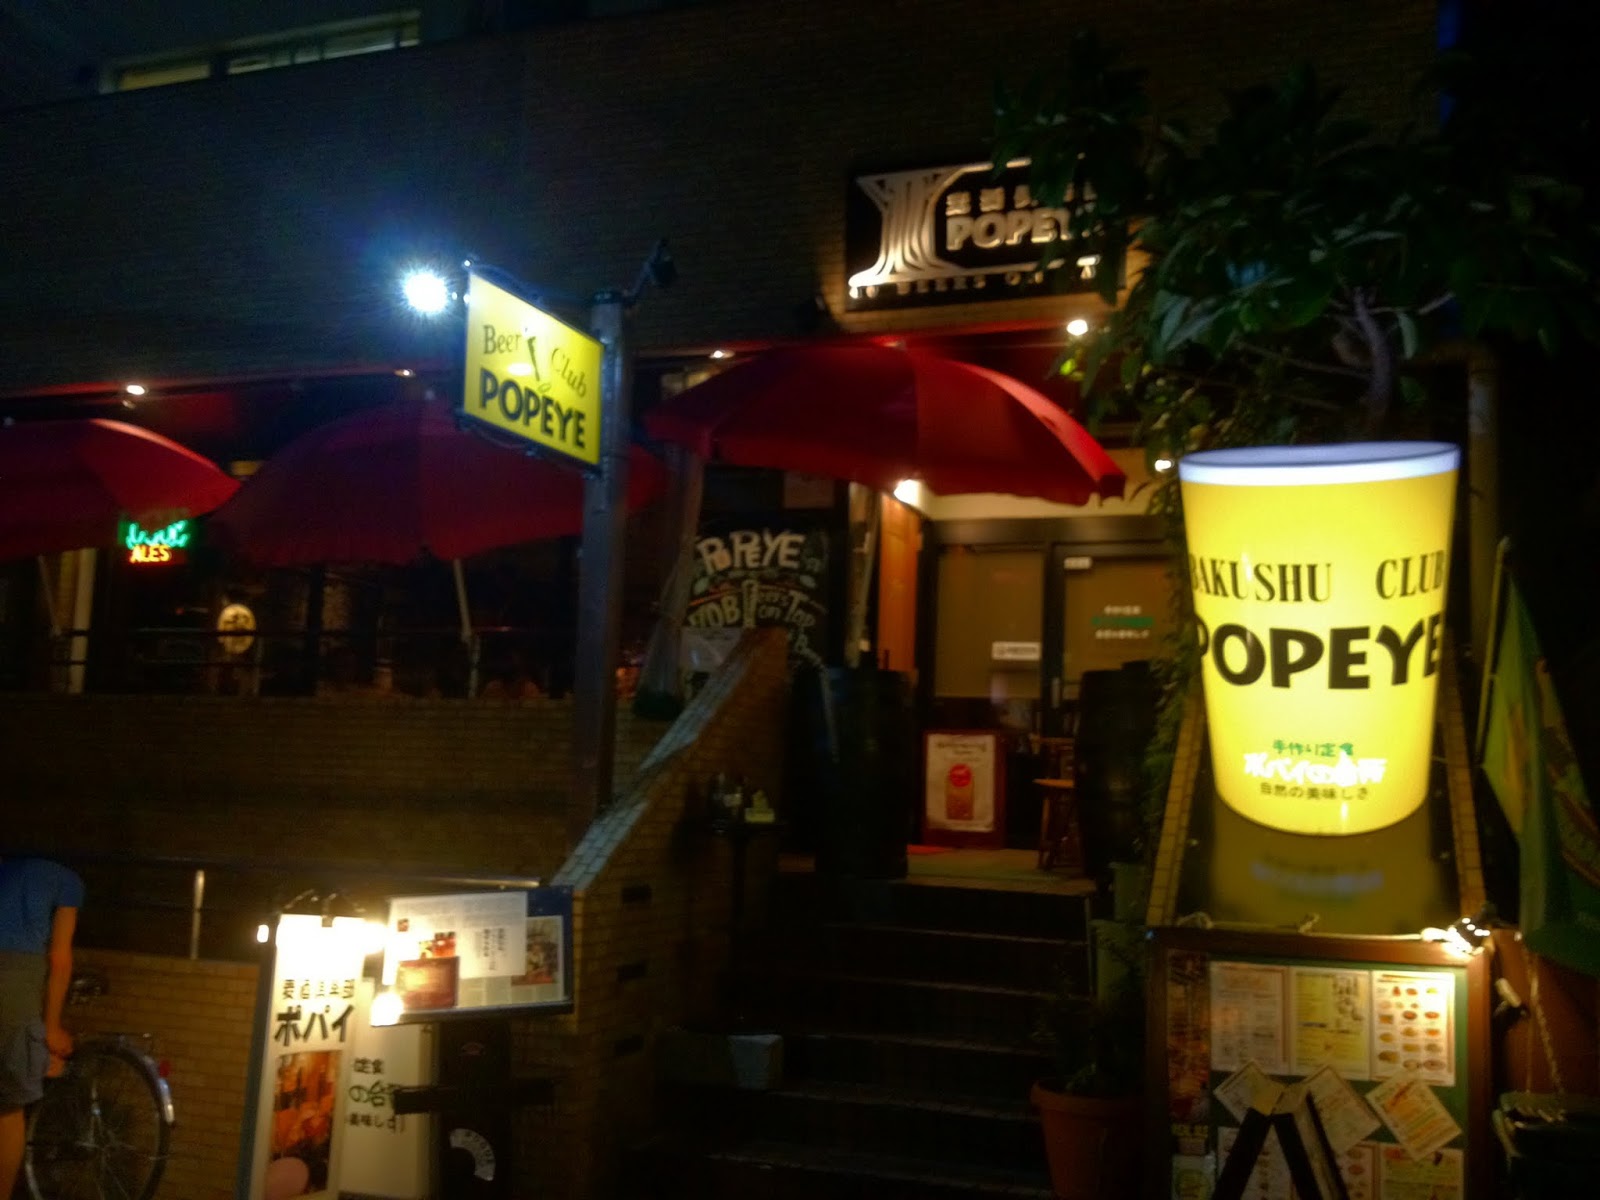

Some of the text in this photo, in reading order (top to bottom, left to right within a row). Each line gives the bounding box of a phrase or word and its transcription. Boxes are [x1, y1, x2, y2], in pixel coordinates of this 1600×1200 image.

[483, 324, 587, 398] Beer Club
[480, 366, 585, 450] POPEYE
[1376, 549, 1445, 600] CLUB
[274, 1004, 356, 1047] ポパイ
